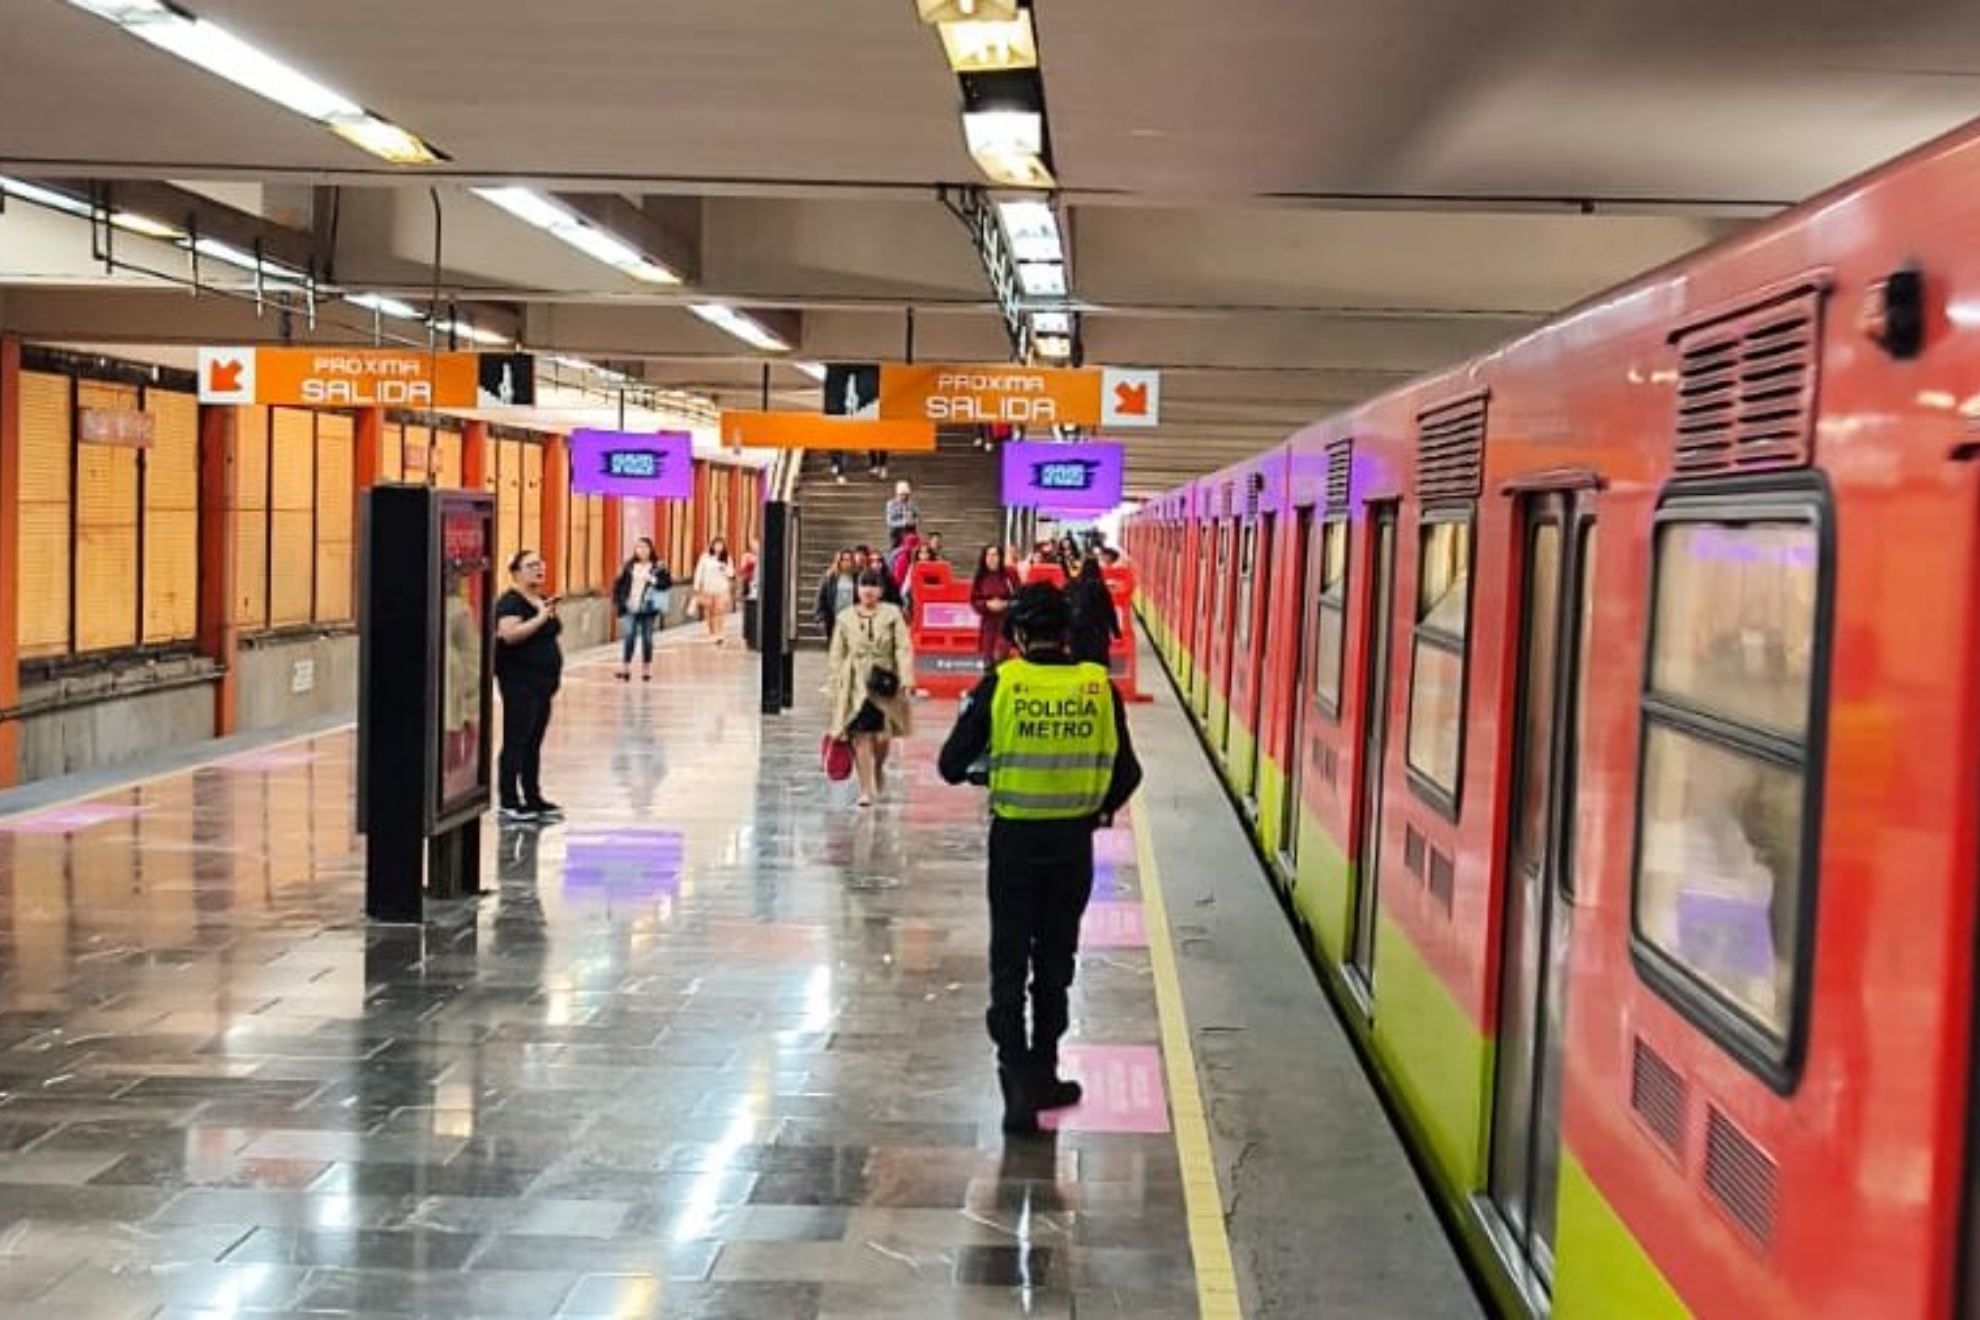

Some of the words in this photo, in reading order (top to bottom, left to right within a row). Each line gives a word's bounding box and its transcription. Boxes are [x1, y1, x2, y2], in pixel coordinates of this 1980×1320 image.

[301, 378, 432, 404] SALIDA
[925, 396, 1056, 421] SALIDA
[1019, 721, 1093, 738] METRO
